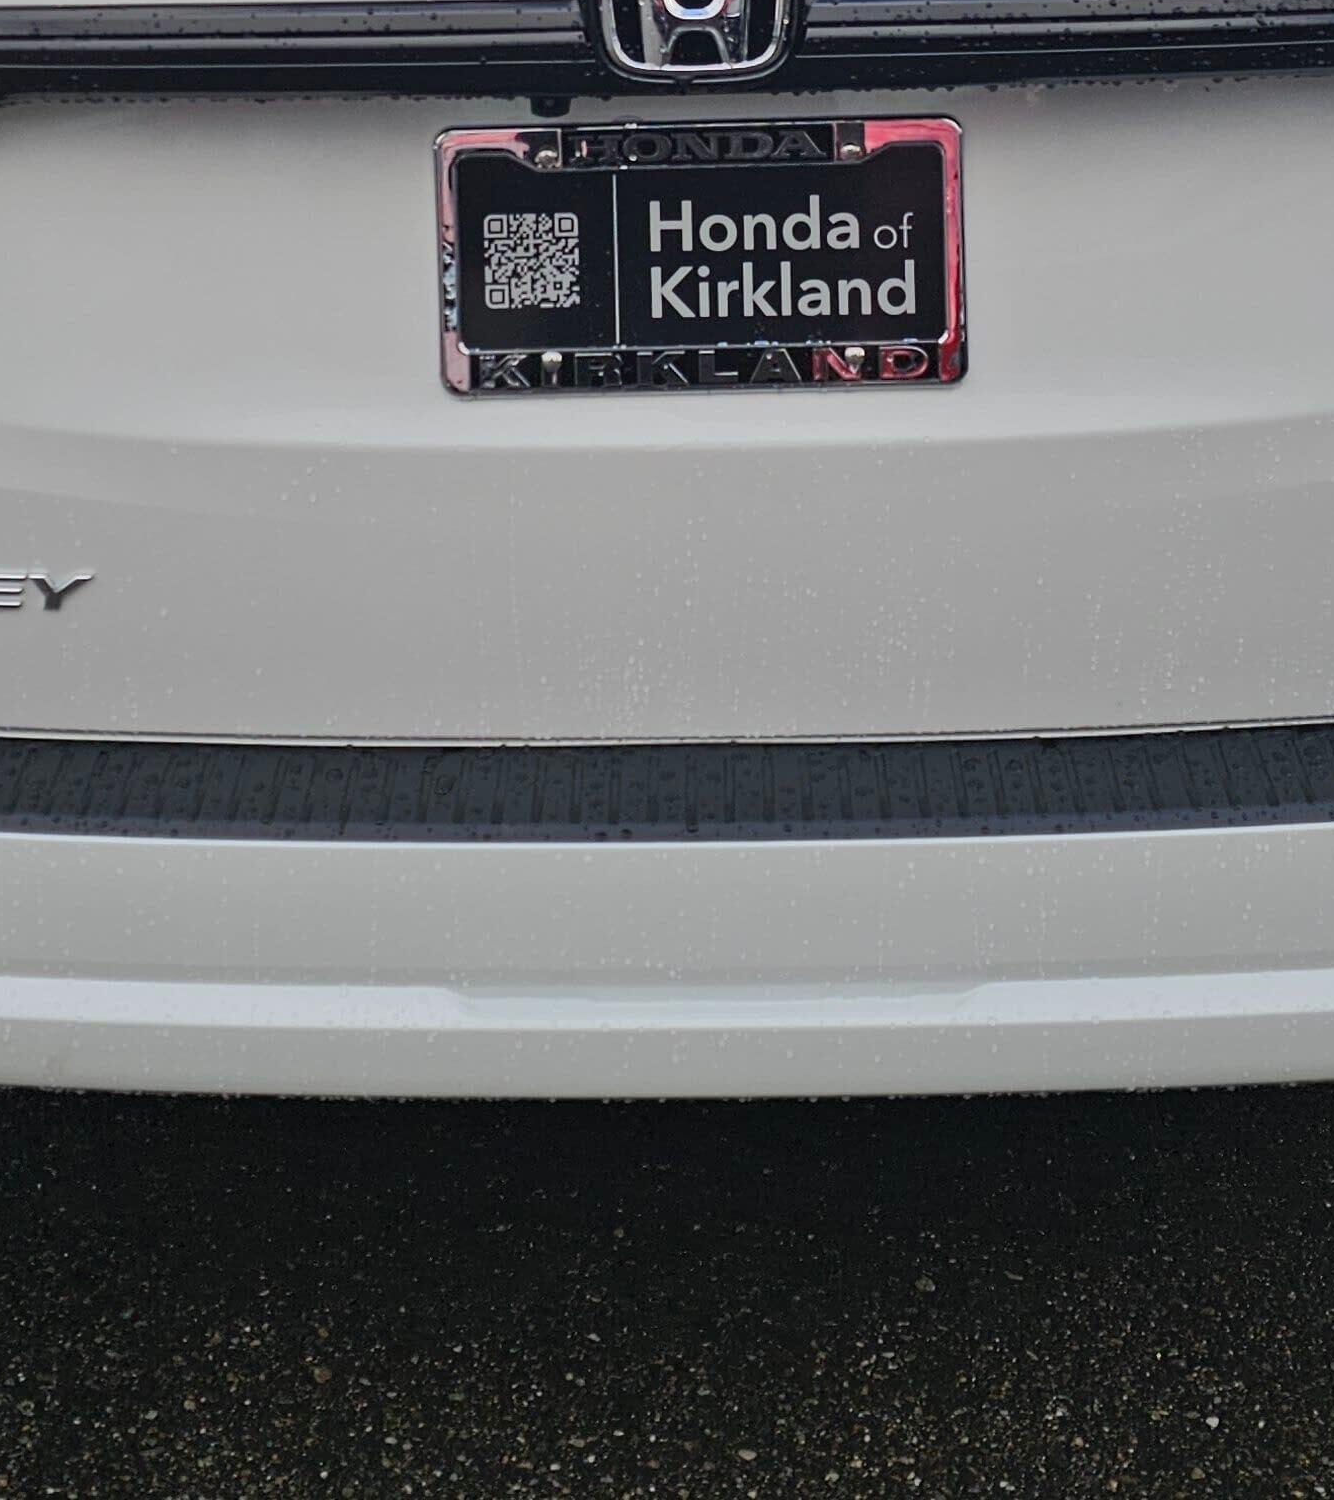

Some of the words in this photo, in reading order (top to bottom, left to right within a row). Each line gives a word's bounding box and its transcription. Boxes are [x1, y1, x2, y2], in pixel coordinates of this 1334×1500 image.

[567, 128, 827, 163] HONDA
[648, 194, 861, 253] Honda
[873, 211, 914, 249] of
[649, 259, 917, 319] Kirkland
